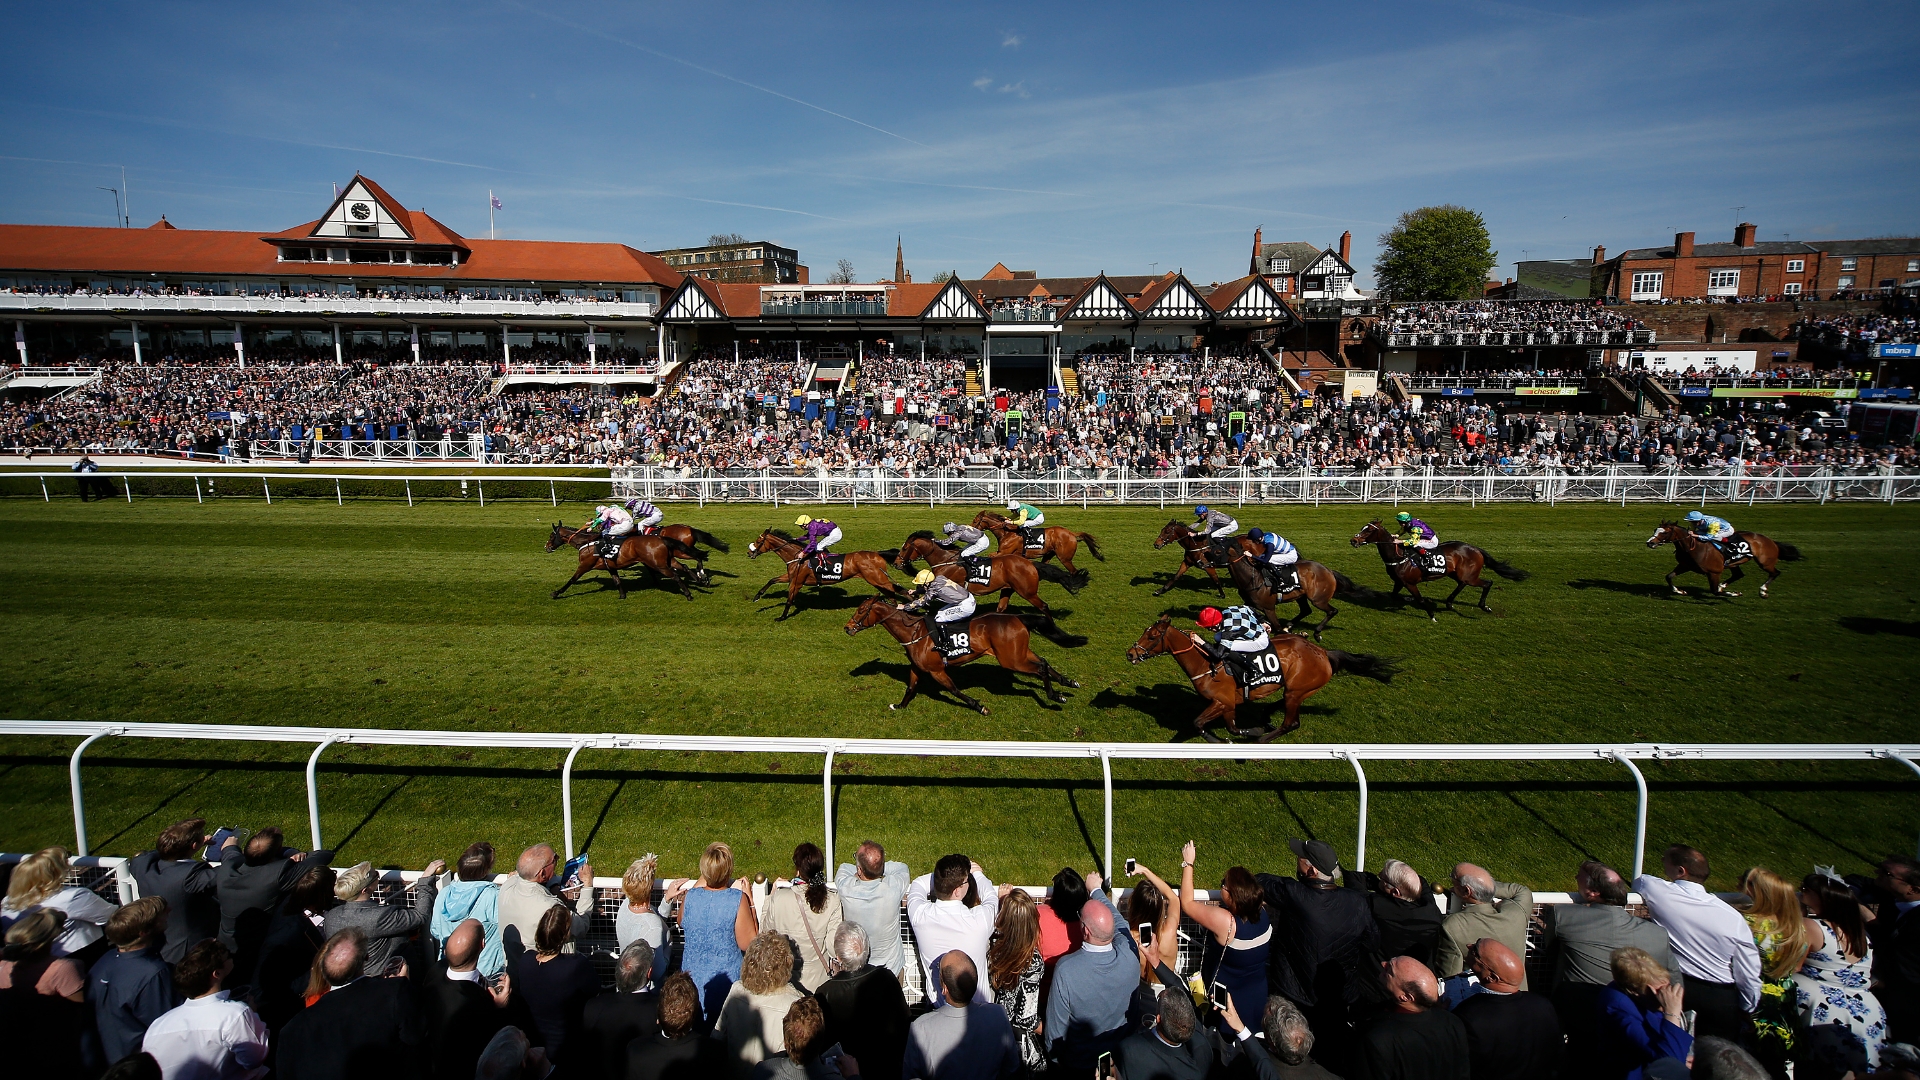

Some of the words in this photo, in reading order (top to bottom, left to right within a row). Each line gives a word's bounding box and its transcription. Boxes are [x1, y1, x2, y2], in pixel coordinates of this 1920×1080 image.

[1800, 389, 1854, 398] chesterBET
[1037, 534, 1045, 544] 4
[1433, 554, 1446, 567] 13
[833, 562, 842, 574] 8
[979, 564, 992, 578] 11
[1428, 566, 1446, 574] etway
[1290, 571, 1299, 584] 1
[949, 632, 969, 647] 18
[1253, 653, 1279, 673] 10
